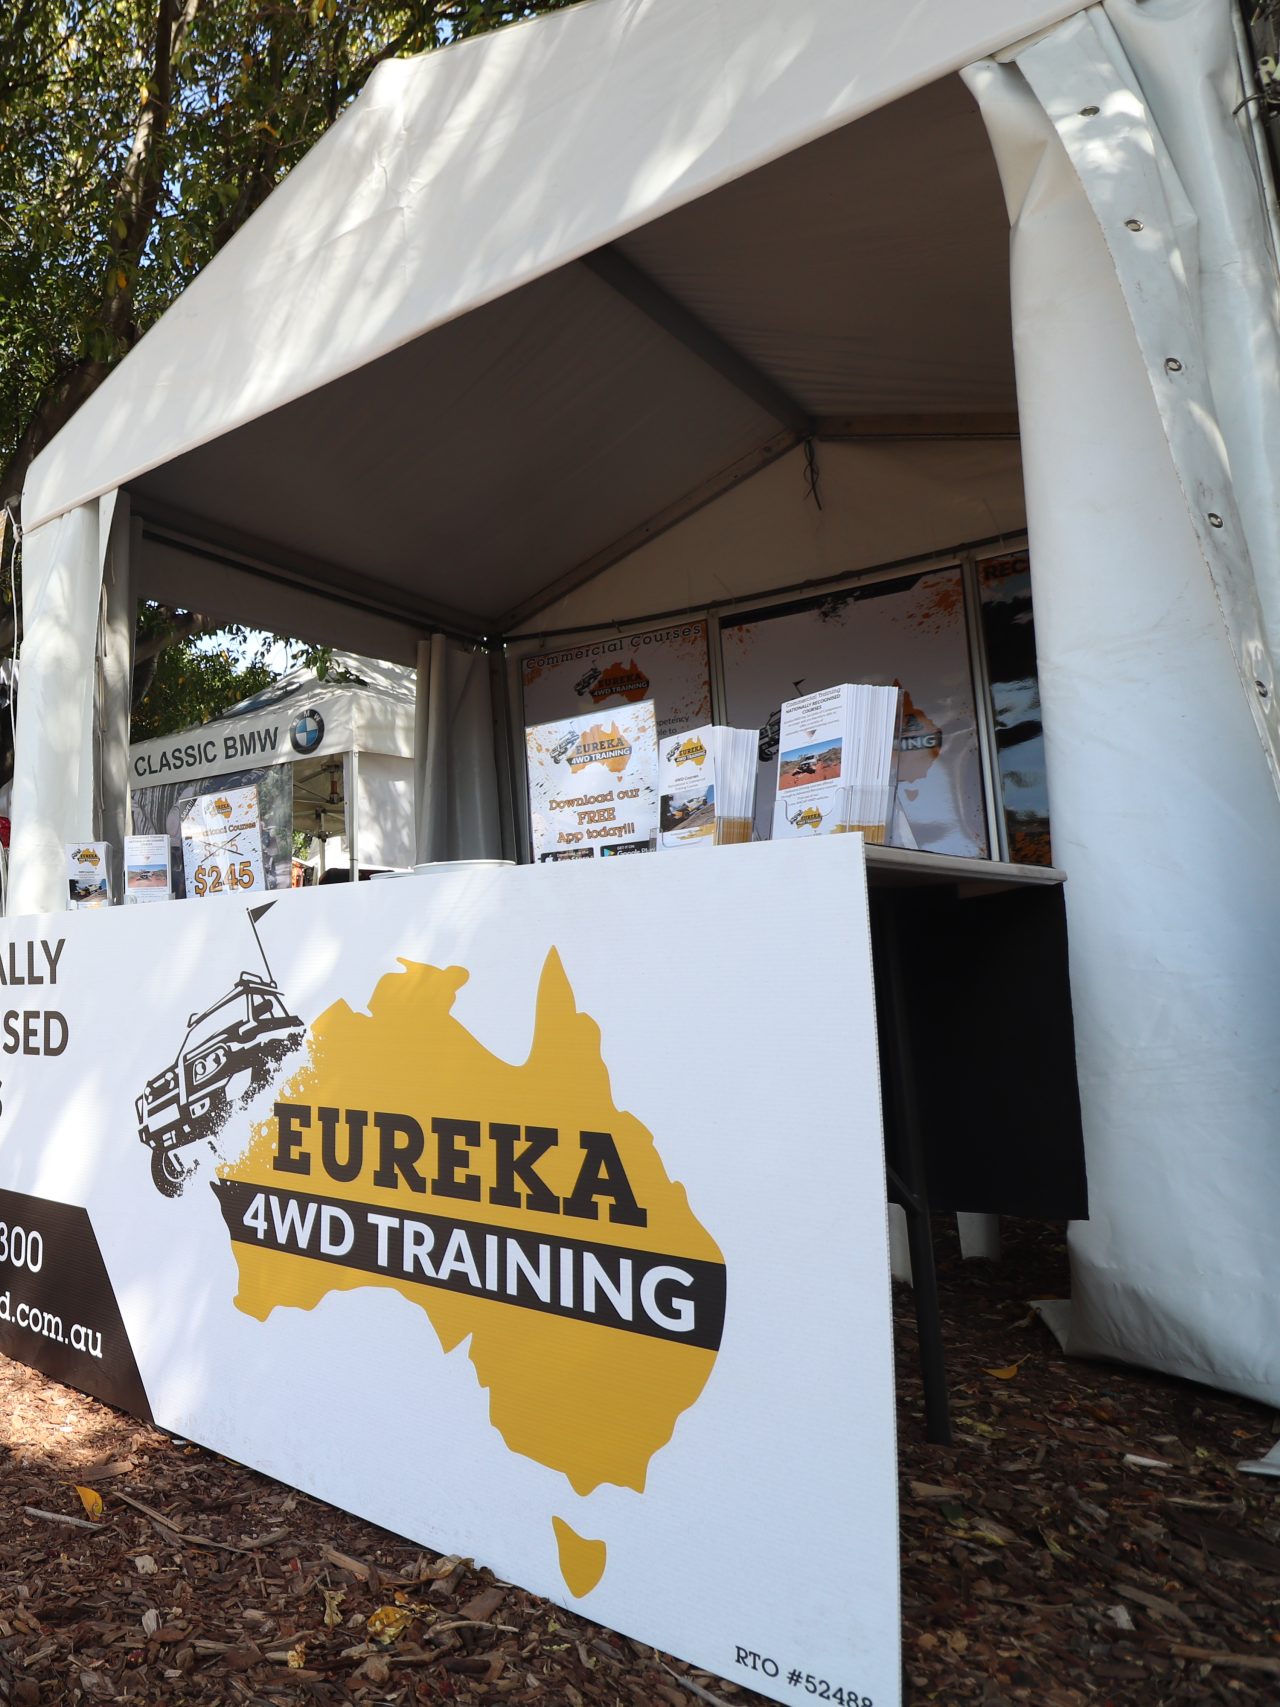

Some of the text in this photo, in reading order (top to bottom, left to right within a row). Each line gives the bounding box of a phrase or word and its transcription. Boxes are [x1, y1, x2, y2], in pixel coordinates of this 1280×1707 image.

[526, 623, 702, 670] Commercial Courses
[592, 681, 648, 697] 4WD TRAINING
[598, 672, 643, 687] EUREKA
[134, 726, 279, 777] CLASSIC BMW
[571, 747, 631, 764] 4WD TRAINING
[575, 737, 625, 754] EUREKA
[678, 745, 704, 757] EUREKA
[549, 788, 641, 811] Download our
[228, 821, 257, 833] Courses
[577, 807, 617, 825] FREE
[557, 822, 635, 844] App today!!!
[194, 860, 255, 898] $245
[272, 1102, 648, 1228] EUREKA
[242, 1193, 696, 1332] 4WD TRAINING
[735, 1645, 779, 1678] RTO
